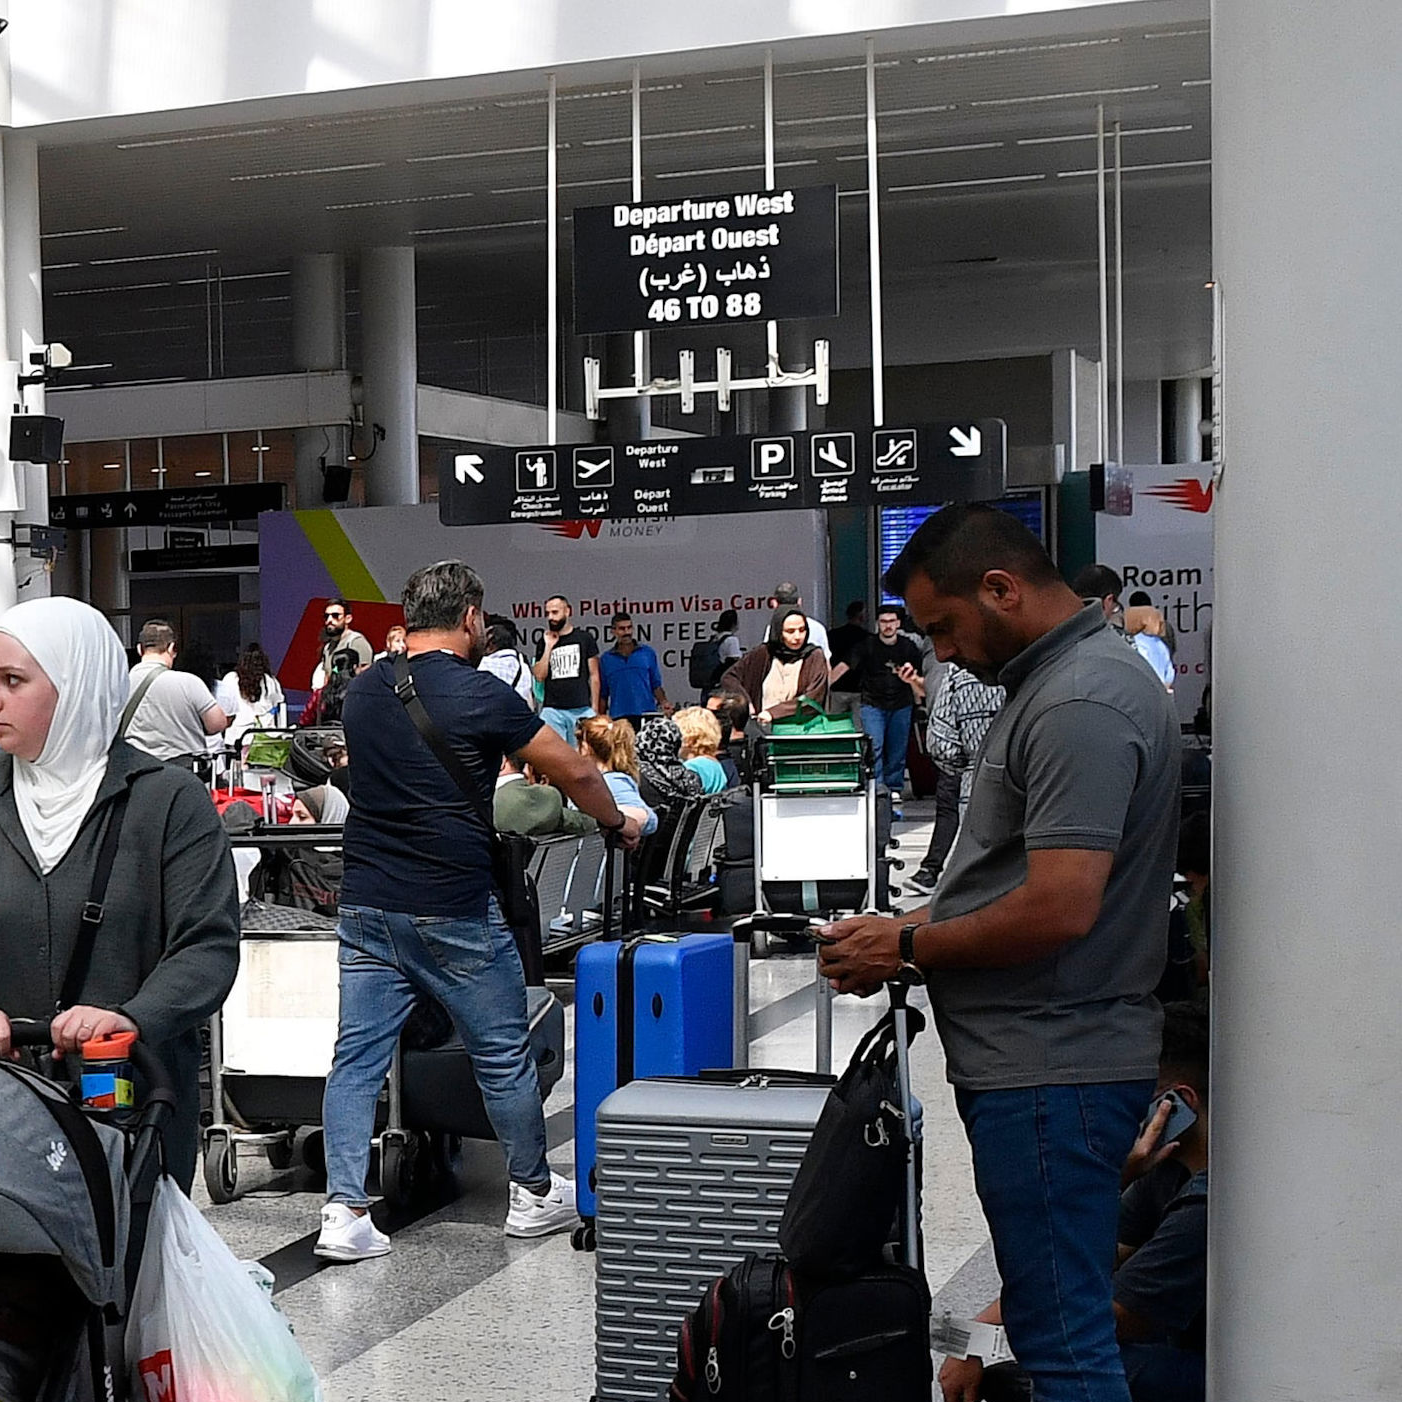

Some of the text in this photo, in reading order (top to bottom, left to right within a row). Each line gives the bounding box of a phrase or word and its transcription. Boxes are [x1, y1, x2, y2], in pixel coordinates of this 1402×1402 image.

[613, 190, 794, 229] Departure West
[630, 223, 780, 258] Départ Ouest
[715, 255, 771, 286] ذهاب
[647, 292, 762, 322] 46 TO 88
[625, 445, 679, 458] Departure
[638, 458, 667, 469] West
[633, 488, 671, 501] Départ
[636, 502, 669, 513] Ouest
[609, 525, 664, 538] MONEY
[1122, 565, 1202, 588] Roam
[579, 595, 675, 617] Platinum
[680, 594, 723, 612] Visa
[1156, 591, 1213, 633] ith
